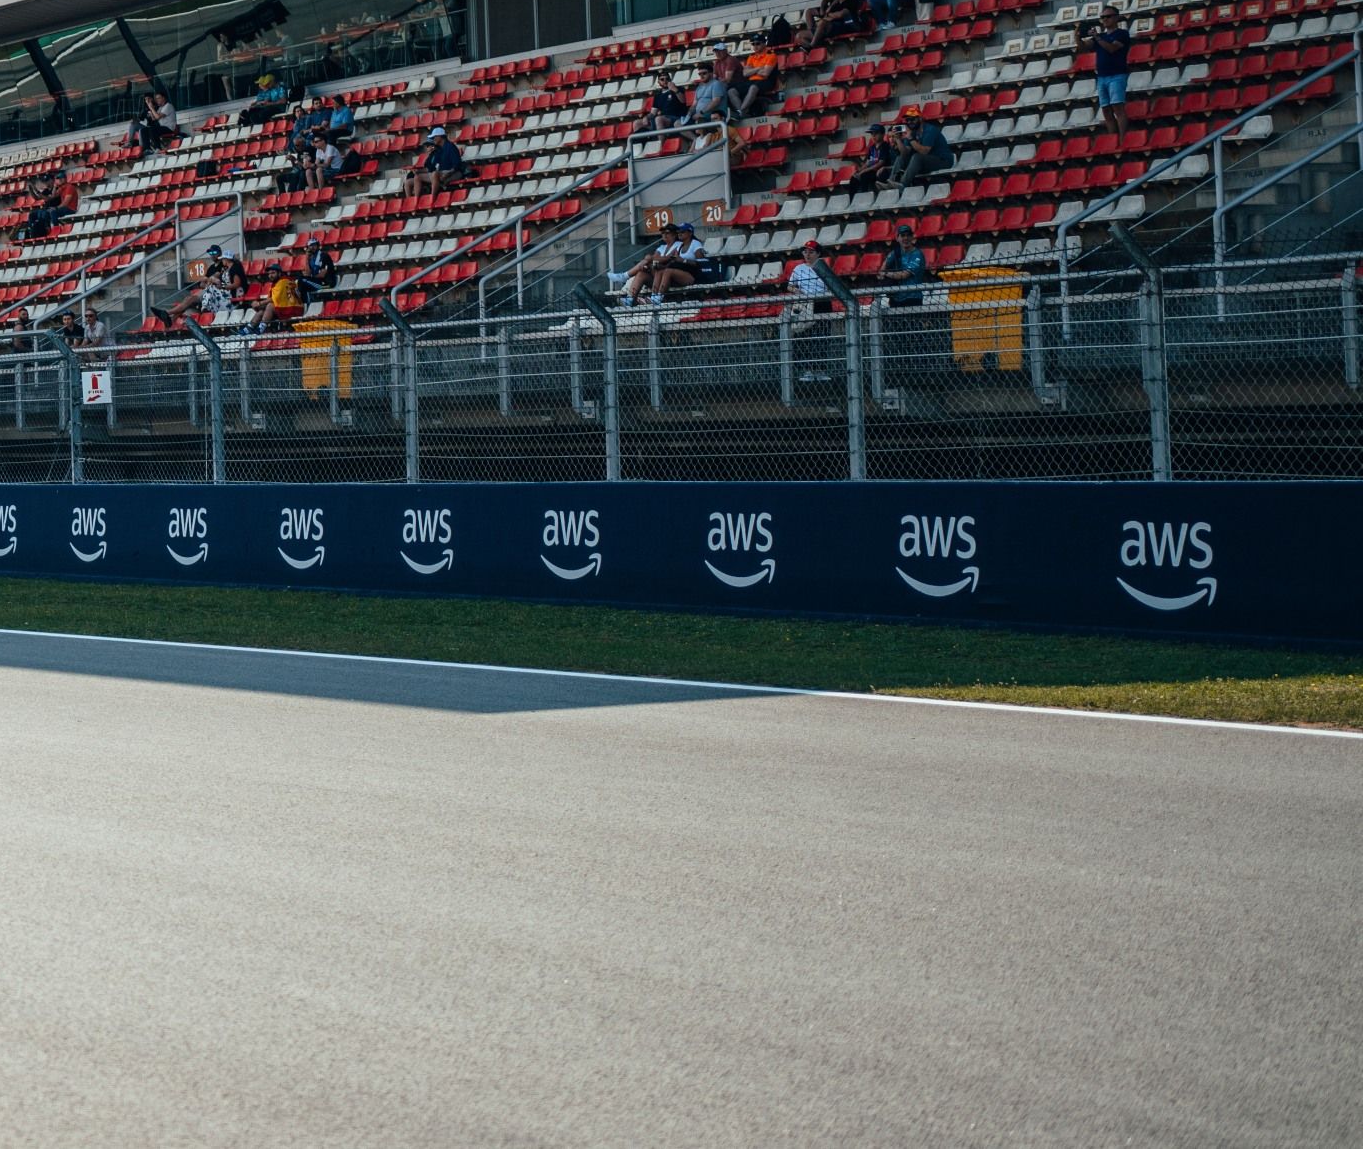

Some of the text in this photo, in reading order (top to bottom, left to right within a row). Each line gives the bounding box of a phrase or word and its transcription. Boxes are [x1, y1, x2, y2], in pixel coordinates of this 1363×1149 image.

[654, 211, 669, 227] 19
[706, 205, 722, 222] 20
[194, 263, 204, 276] 18
[72, 508, 105, 536] aws
[169, 508, 207, 538] aws
[280, 508, 323, 540] aws
[403, 509, 451, 543] aws
[543, 510, 599, 547] aws
[708, 512, 772, 552] aws
[900, 515, 976, 559] aws
[1121, 521, 1212, 568] aws
